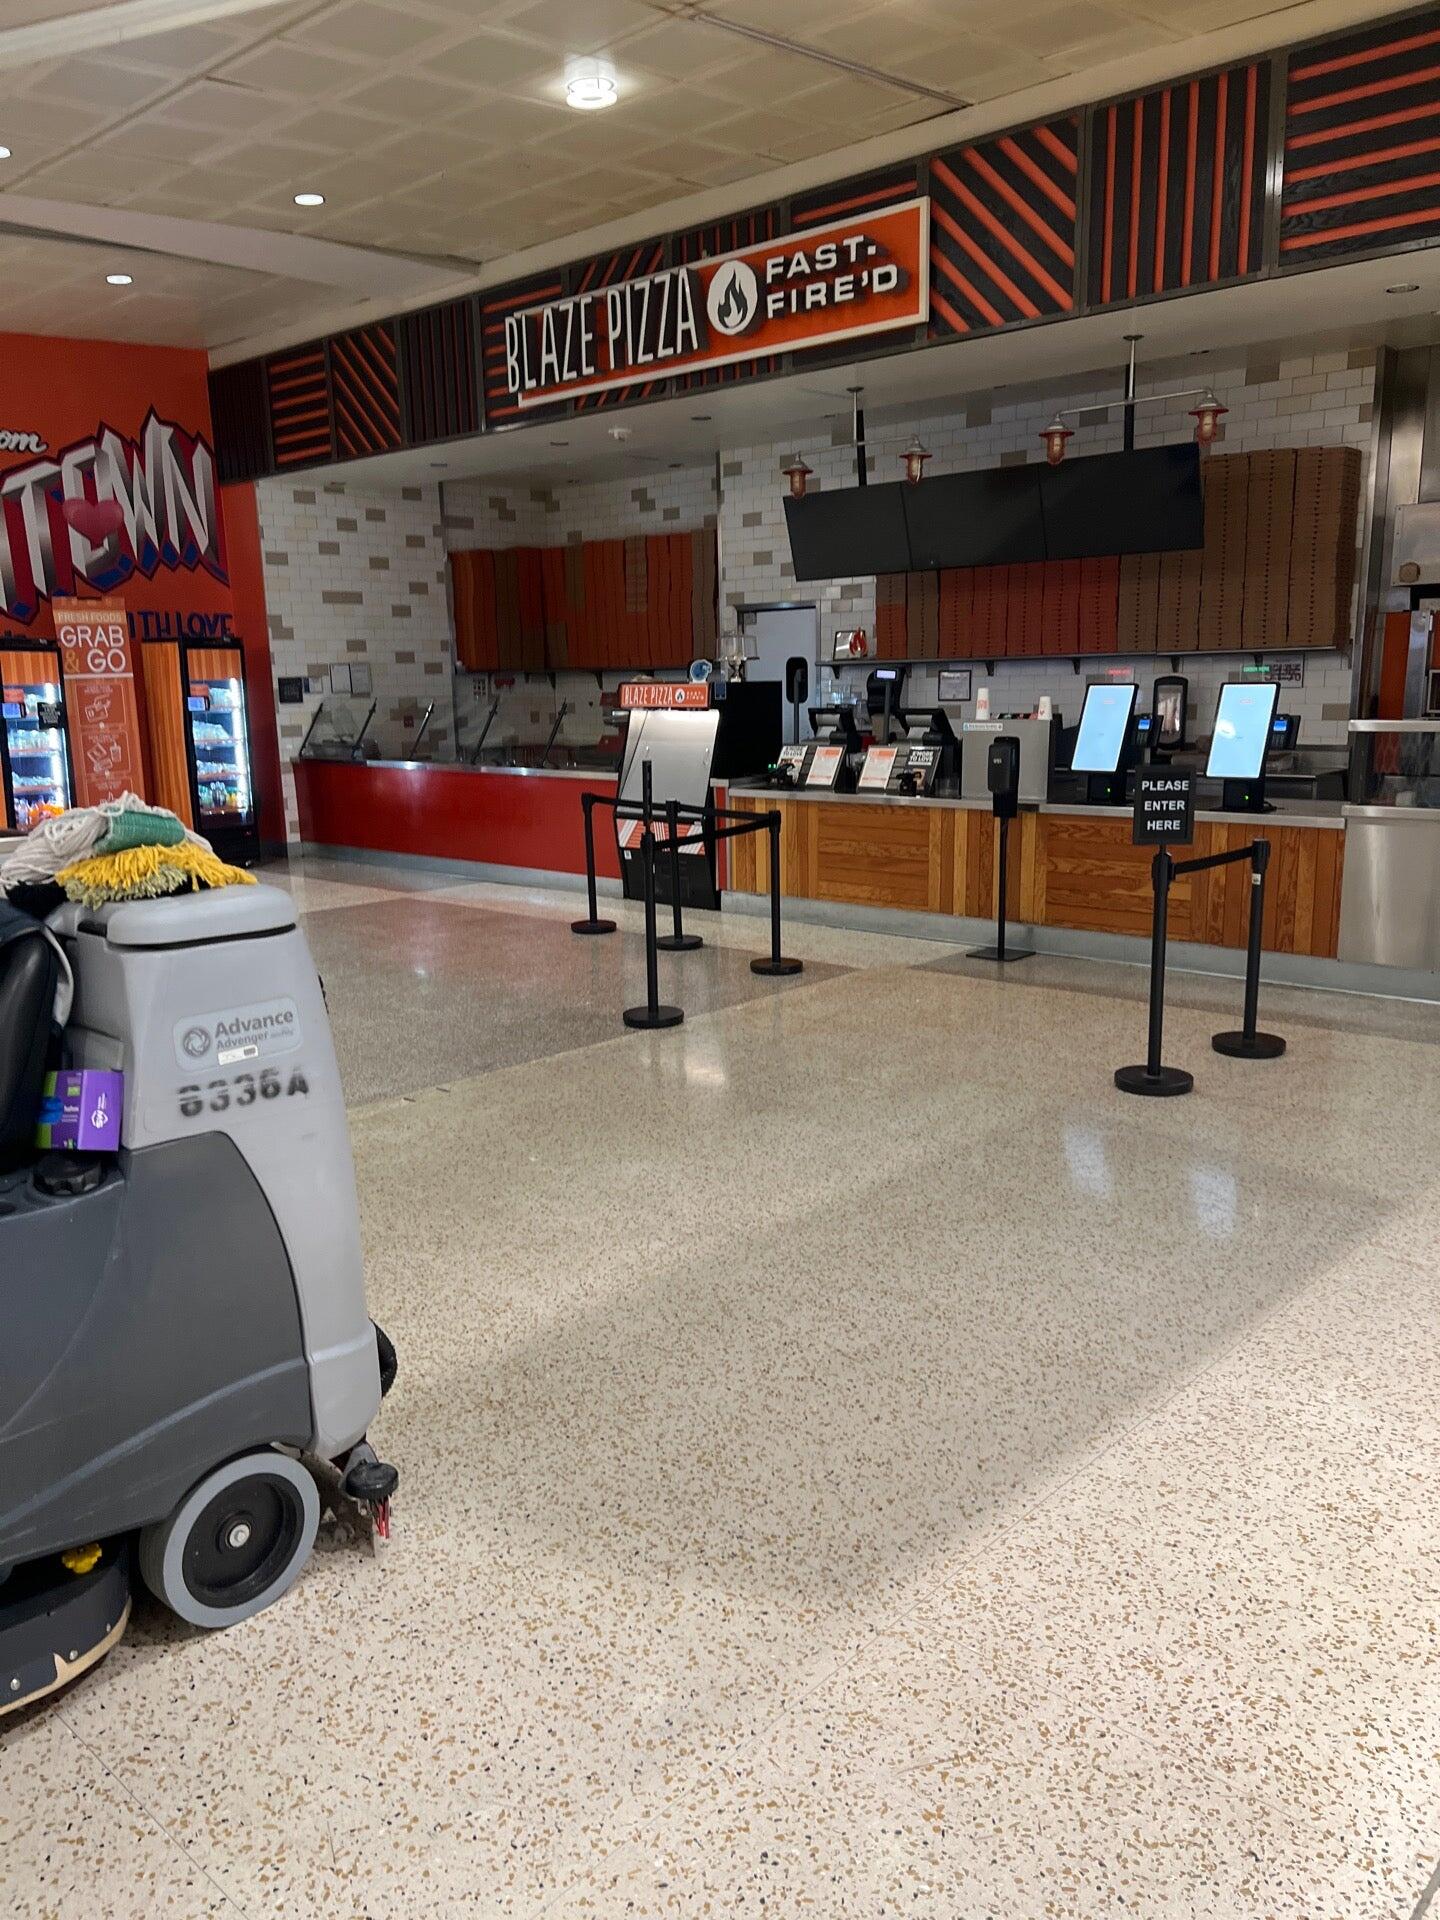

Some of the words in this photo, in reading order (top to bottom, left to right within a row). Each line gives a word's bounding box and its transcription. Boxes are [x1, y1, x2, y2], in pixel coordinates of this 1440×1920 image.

[766, 263, 898, 319] FIRE'D
[504, 296, 595, 394] BLAZE
[606, 268, 699, 370] PIZZA
[126, 609, 171, 639] ITH
[175, 610, 233, 638] LOVE
[60, 625, 124, 648] GRAB
[64, 649, 80, 673] &
[86, 648, 126, 673] GO
[624, 686, 648, 705] BLAZE
[650, 686, 673, 705] PIZZA
[1141, 780, 1189, 791] PLEASE
[1144, 800, 1185, 811] ENTER
[1146, 820, 1181, 831] HERE
[215, 1010, 294, 1039] Advance
[216, 1032, 268, 1051] Advenger
